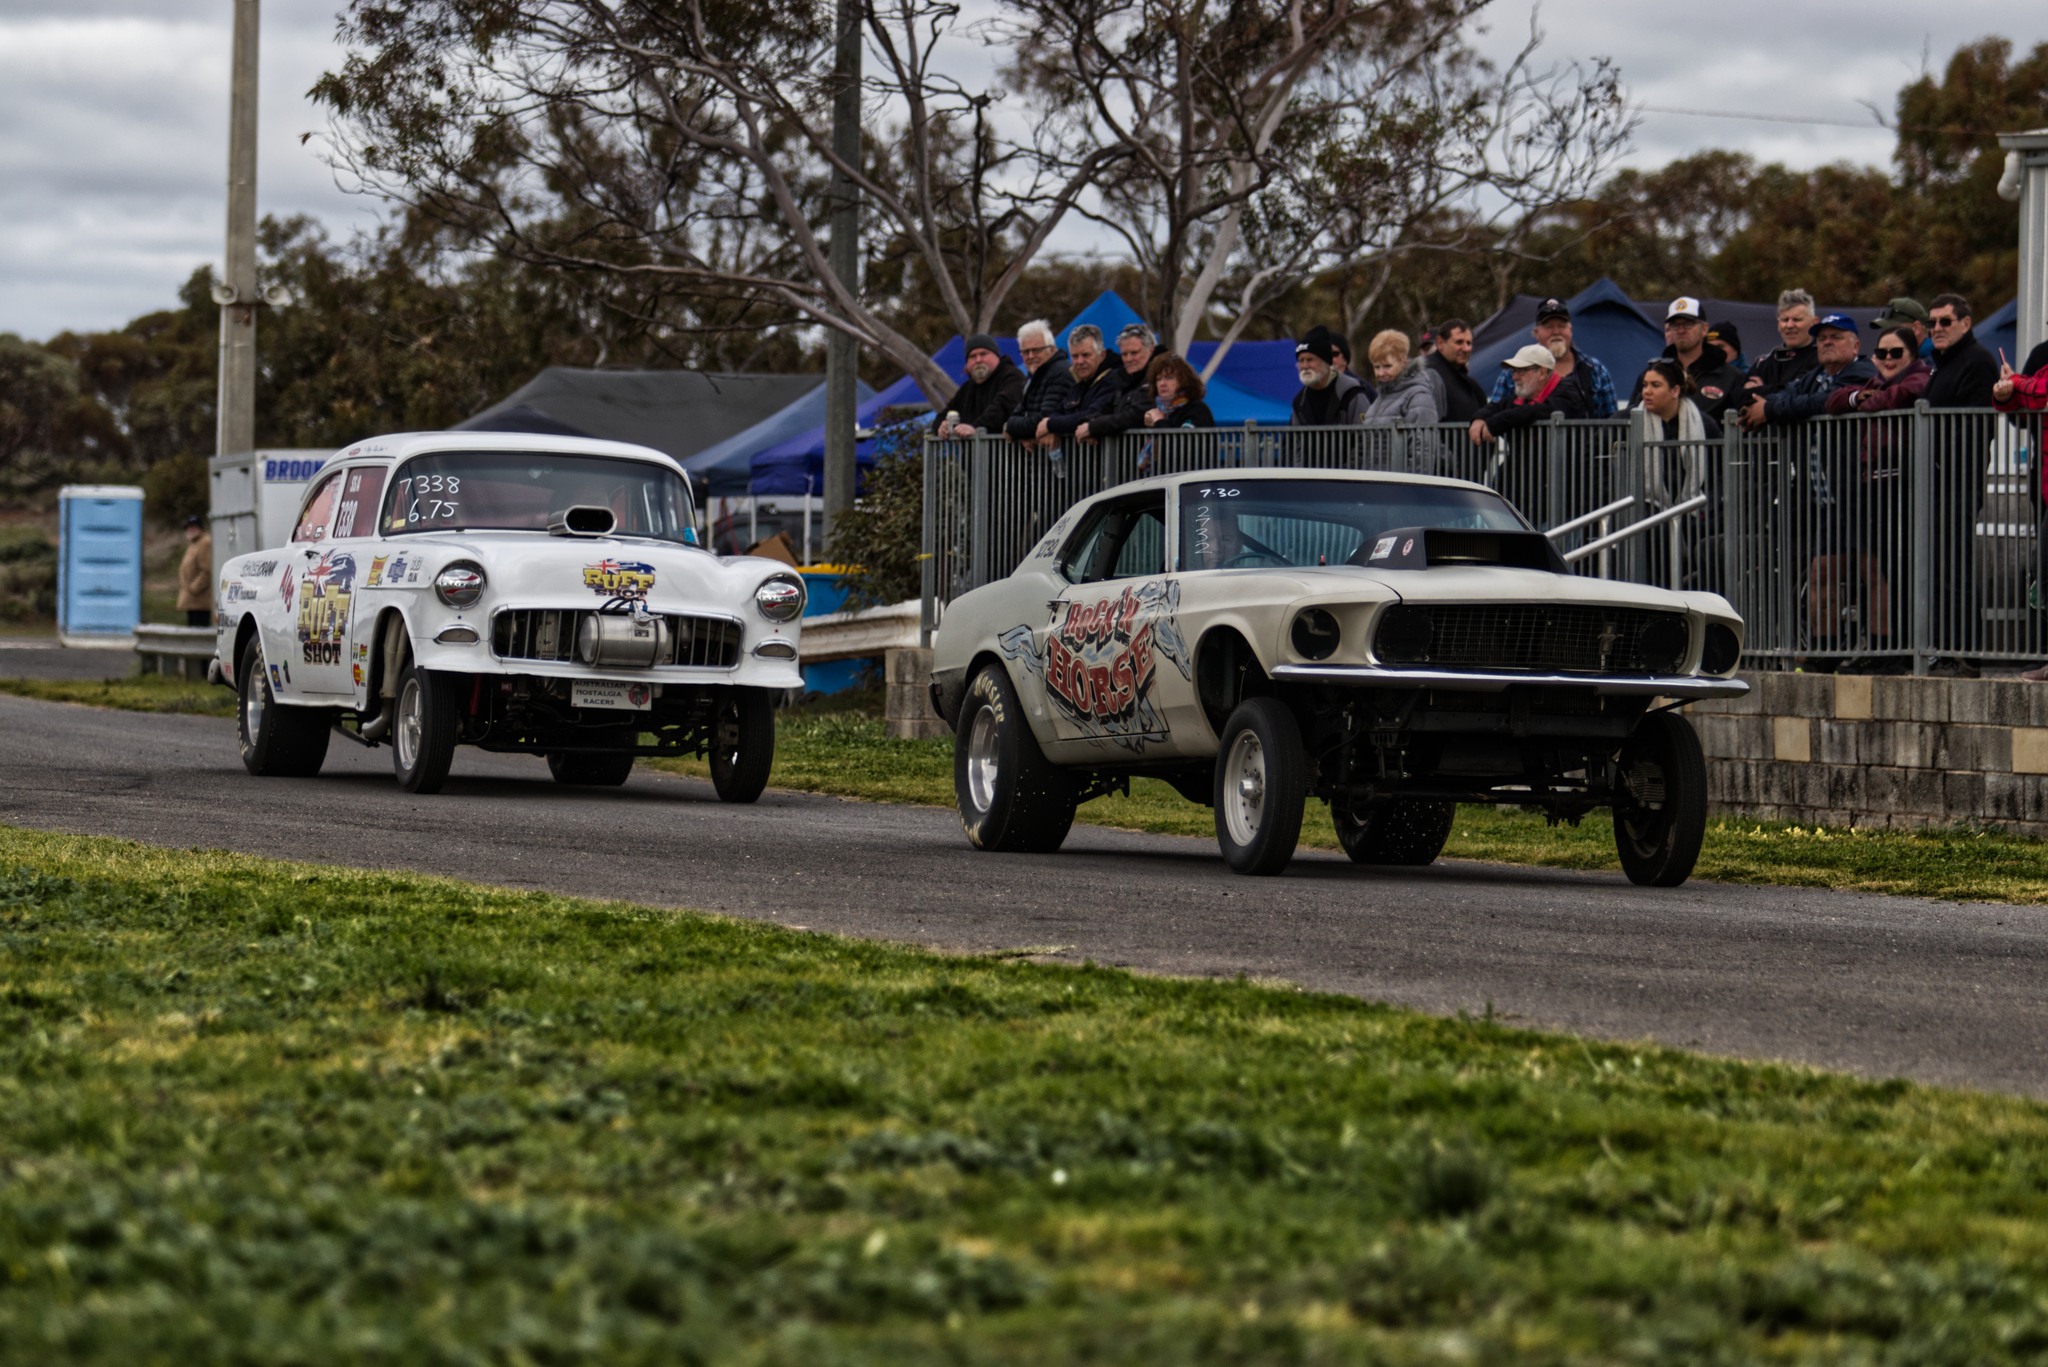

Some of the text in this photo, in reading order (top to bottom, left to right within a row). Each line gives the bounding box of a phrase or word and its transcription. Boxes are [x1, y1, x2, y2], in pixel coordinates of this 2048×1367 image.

[399, 474, 461, 496] 7338
[334, 499, 359, 538] 7338
[408, 498, 460, 523] 6.75
[583, 568, 655, 590] RUFF
[594, 588, 649, 598] SHOT
[297, 580, 352, 643] RUFF
[303, 641, 342, 667] SHOT
[1047, 620, 1156, 717] HORSE
[574, 680, 627, 690] AUSTRALIAN
[576, 688, 623, 697] NOSTALGIA
[583, 698, 616, 706] RACERS
